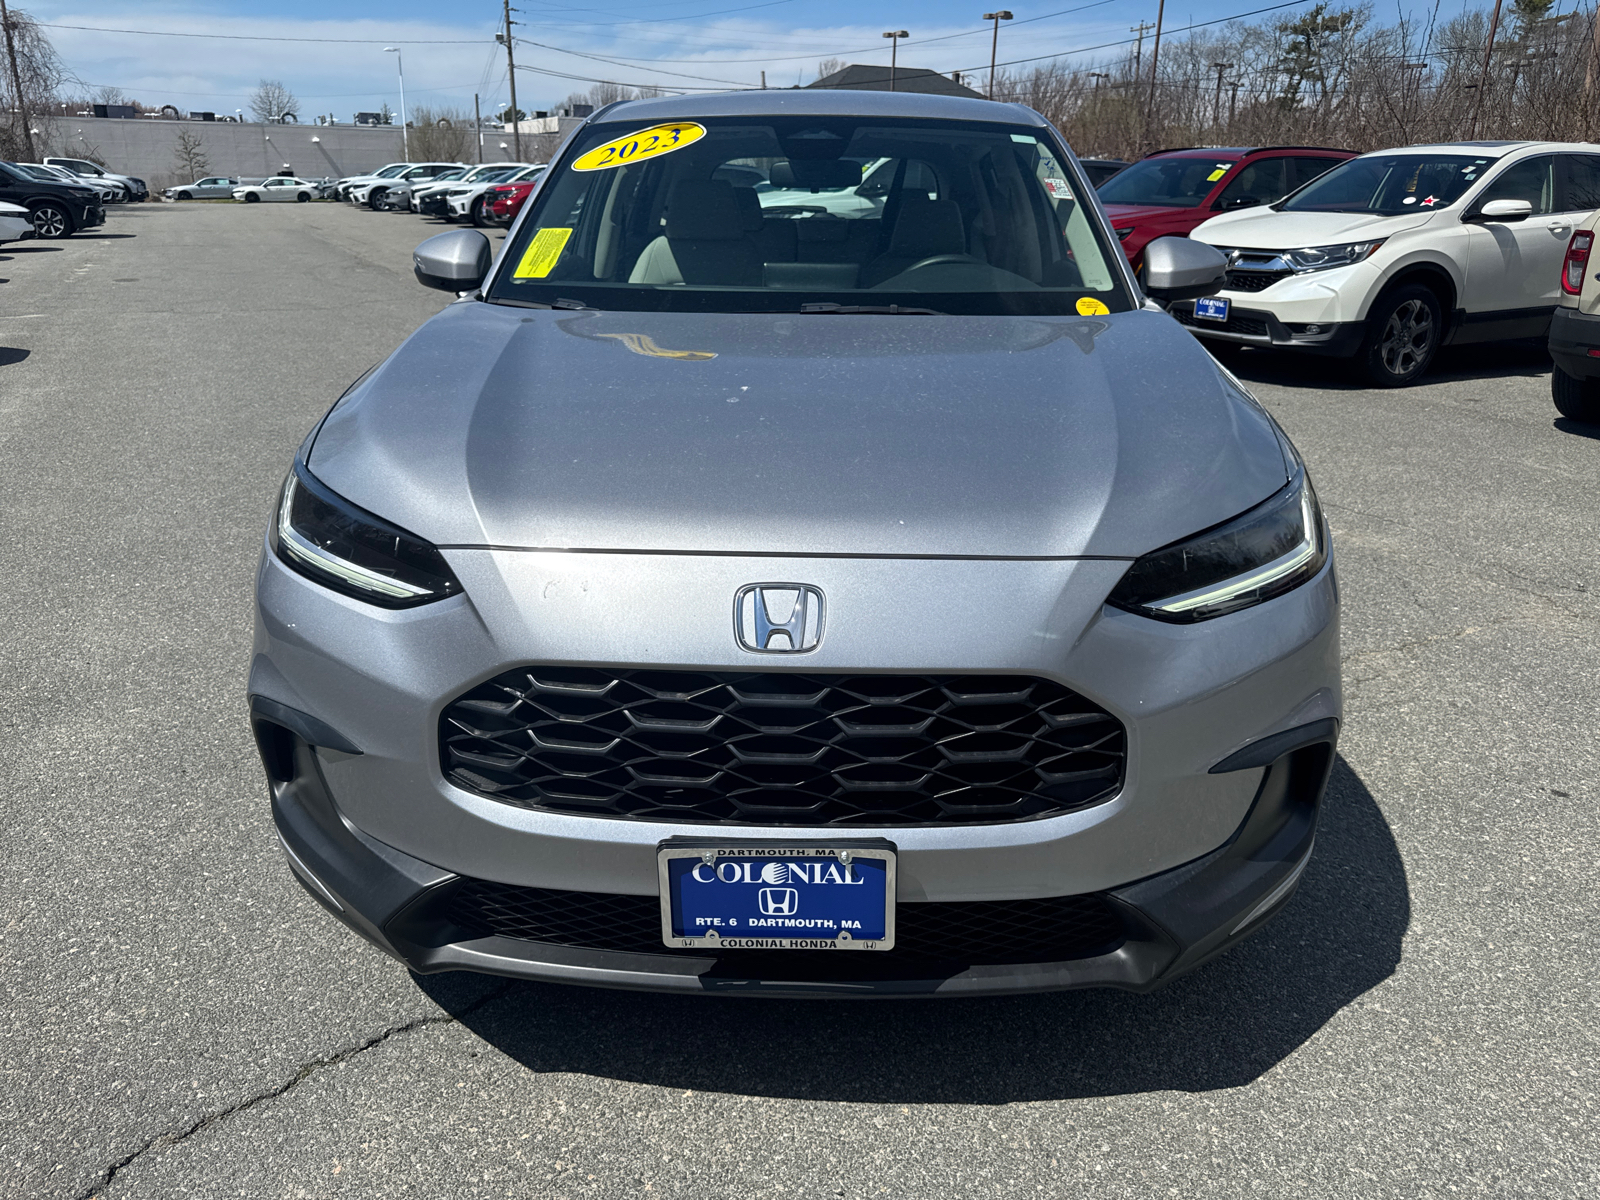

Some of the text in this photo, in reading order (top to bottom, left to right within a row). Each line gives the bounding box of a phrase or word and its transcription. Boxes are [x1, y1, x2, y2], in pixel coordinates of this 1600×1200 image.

[596, 128, 681, 166] 2023
[692, 862, 864, 885] COLONIAL
[695, 917, 862, 929] RTE. 6 DARTMOUTH, MA
[720, 939, 837, 948] COLONIAL HONDA
